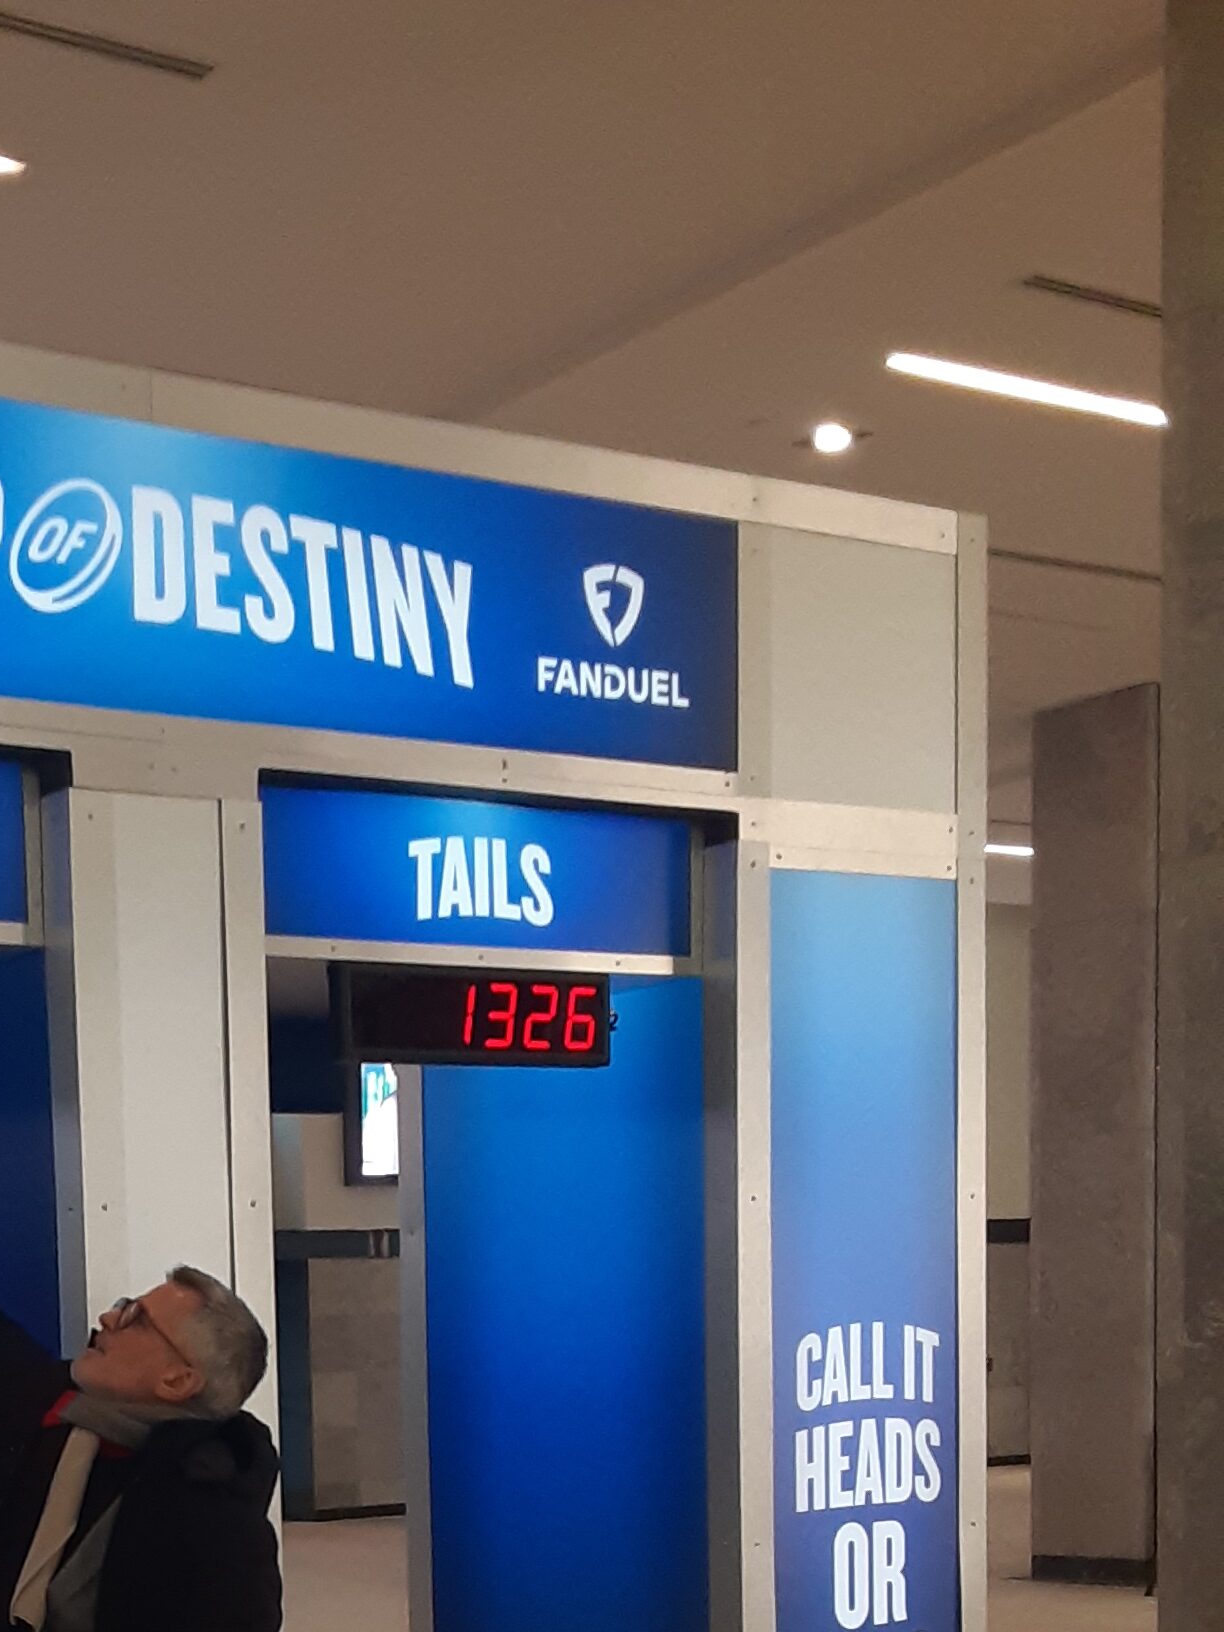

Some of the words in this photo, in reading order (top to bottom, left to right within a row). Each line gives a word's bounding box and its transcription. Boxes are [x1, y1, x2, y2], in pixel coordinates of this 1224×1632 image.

[27, 516, 98, 564] OF
[131, 484, 473, 689] DESTINY
[536, 656, 689, 708] FANDUEL
[408, 836, 554, 927] TAILS
[462, 982, 597, 1052] 1326
[795, 1321, 894, 1412] CALL
[903, 1324, 939, 1403] IT
[794, 1417, 942, 1513] HEADS
[833, 1519, 908, 1630] OR
